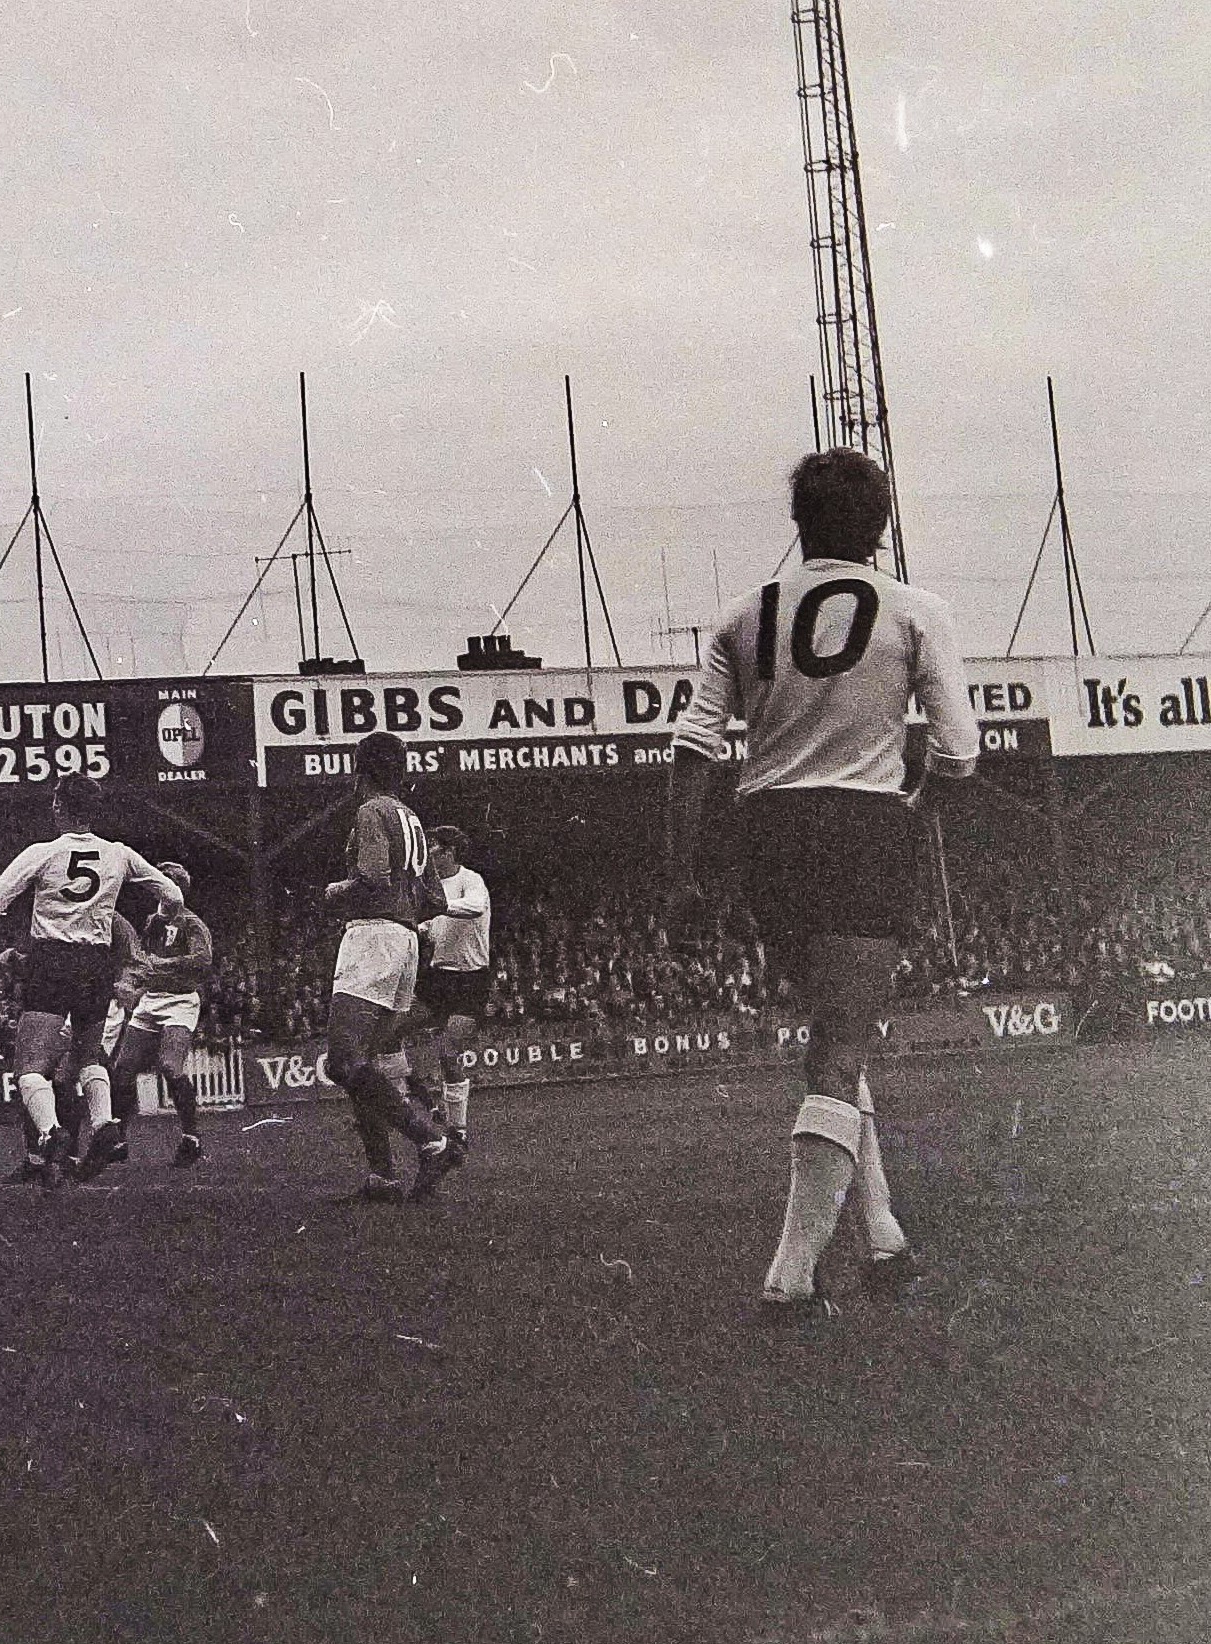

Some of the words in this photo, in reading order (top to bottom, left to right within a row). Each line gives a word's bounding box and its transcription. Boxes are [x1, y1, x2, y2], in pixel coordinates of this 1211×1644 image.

[756, 578, 879, 681] 10
[158, 689, 197, 700] MAIN
[270, 686, 464, 735] GIBBS
[488, 697, 596, 731] AND
[1083, 677, 1144, 727] It's
[161, 727, 201, 742] OPEL
[158, 770, 207, 781] DEALER
[459, 743, 619, 772] MERCHANTS
[634, 743, 675, 764] and
[395, 808, 428, 878] 10
[59, 850, 101, 902] 5
[982, 1001, 1062, 1037] V&G
[1147, 997, 1211, 1023] FOOT
[462, 1041, 584, 1067] DOUBLE
[633, 1031, 732, 1056] BONUS
